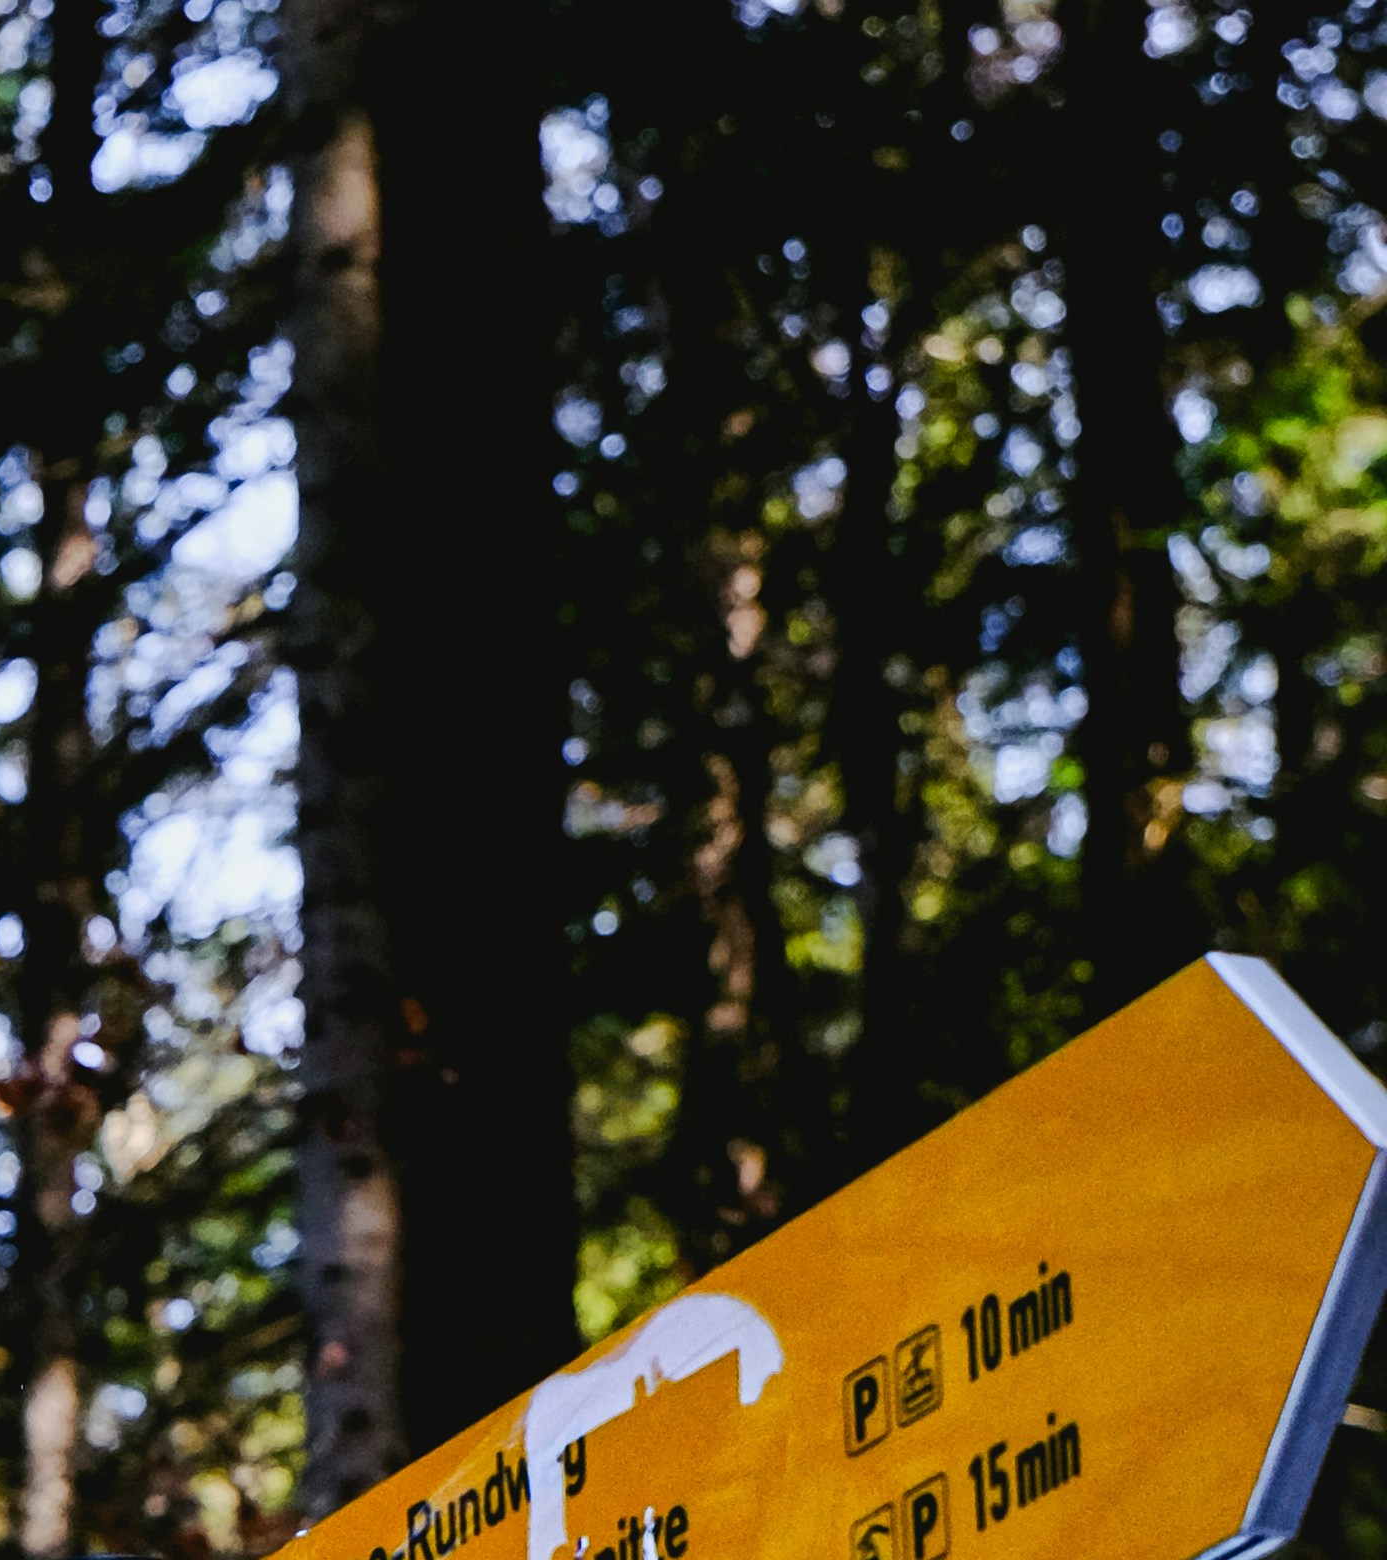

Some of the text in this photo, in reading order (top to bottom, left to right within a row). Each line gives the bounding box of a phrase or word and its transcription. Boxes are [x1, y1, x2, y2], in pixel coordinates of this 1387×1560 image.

[961, 1293, 1003, 1383] 10
[1008, 1260, 1074, 1358] min
[969, 1441, 1010, 1532] 15
[1015, 1411, 1081, 1509] min
